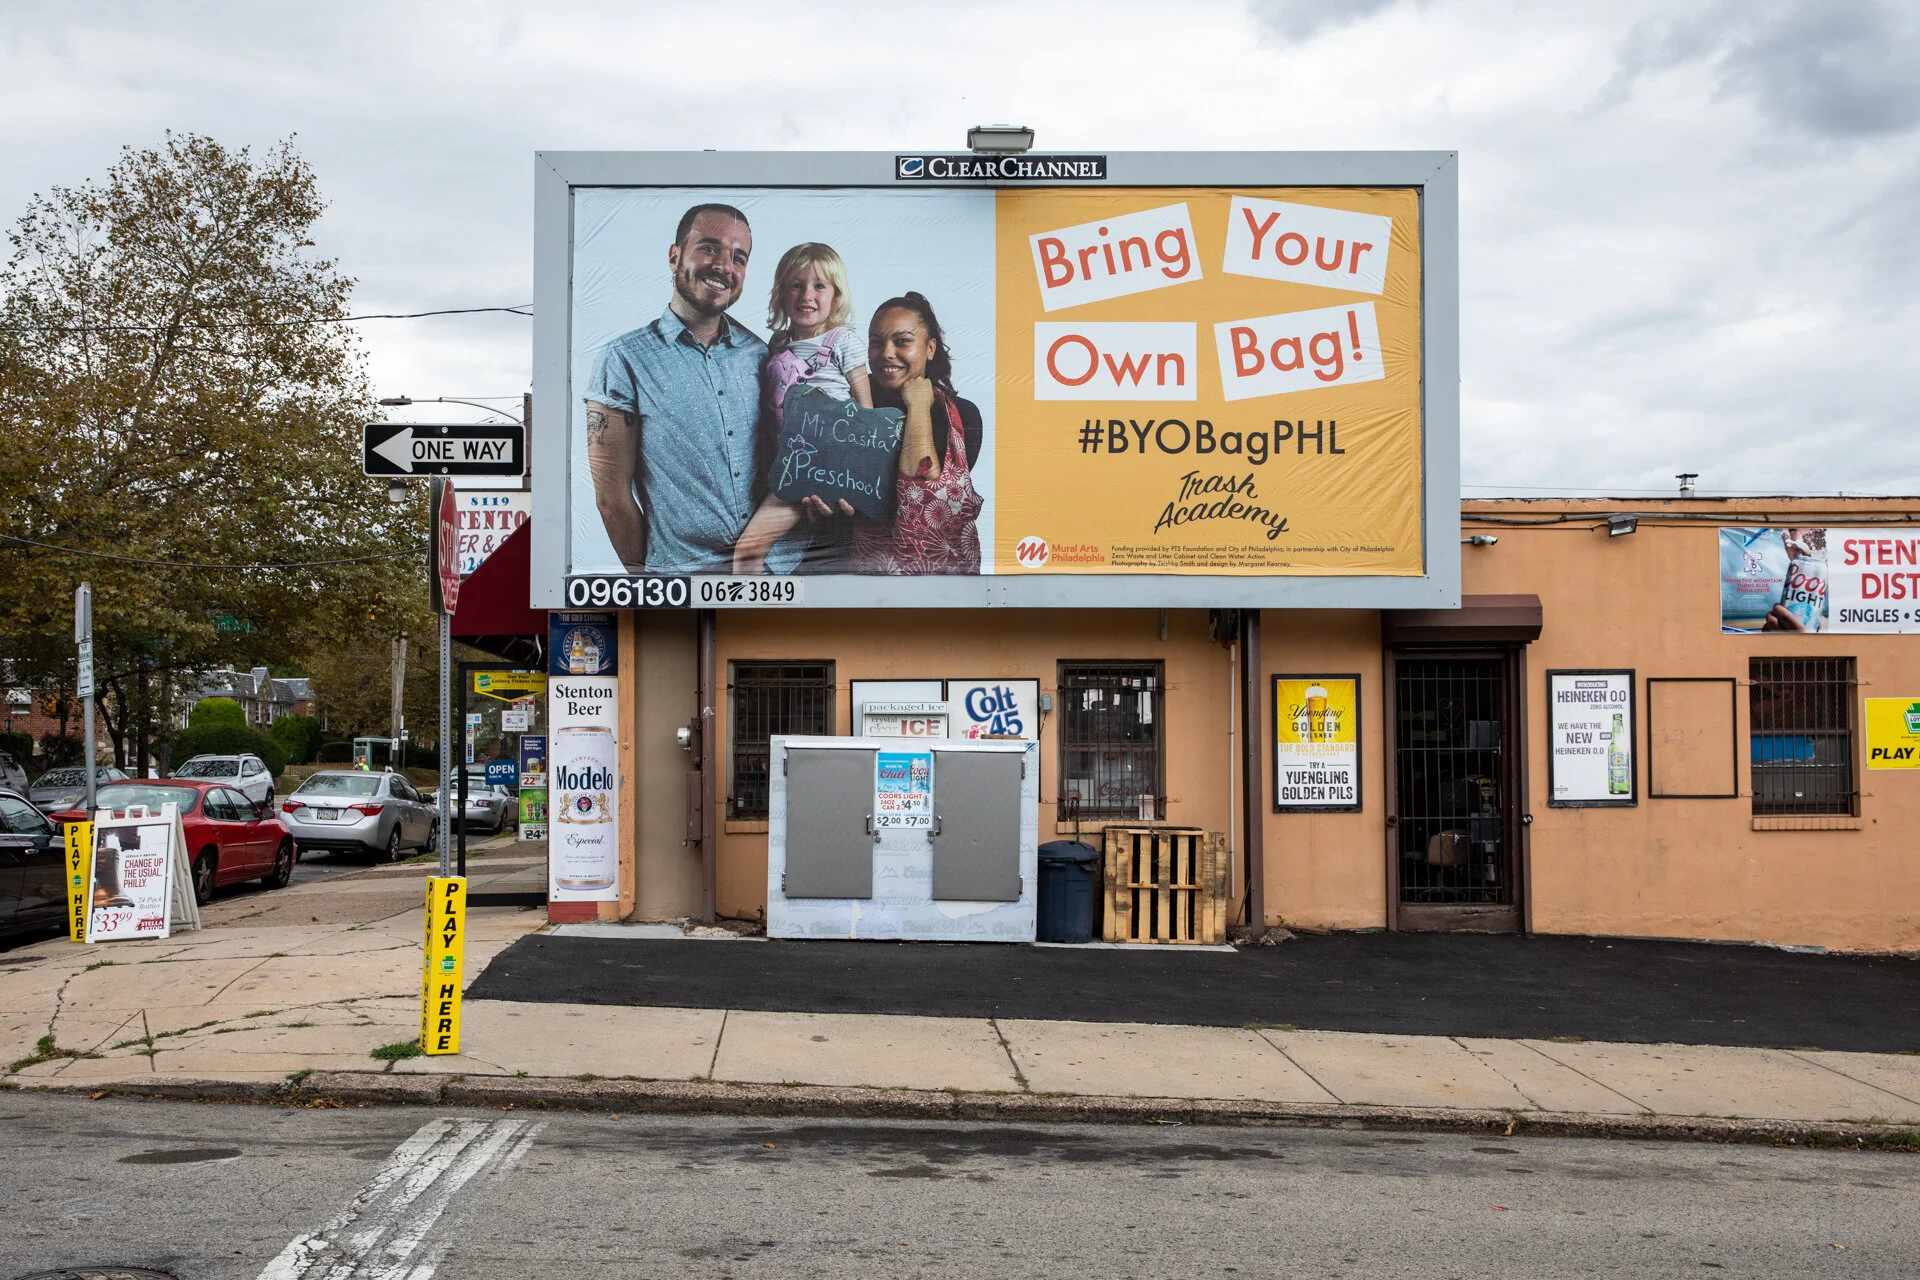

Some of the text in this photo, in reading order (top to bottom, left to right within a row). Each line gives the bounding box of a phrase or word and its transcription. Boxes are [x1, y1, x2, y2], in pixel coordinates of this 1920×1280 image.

[1037, 207, 1373, 289] Bring Your
[1046, 310, 1362, 387] Own Bag!
[801, 411, 890, 452] Mi Casita
[1078, 419, 1345, 465] #BYOBagPHL
[412, 440, 507, 460] ONE WAY
[795, 452, 882, 499] Preschool
[1178, 470, 1258, 502] Trash
[471, 497, 510, 506] 8119
[458, 510, 528, 530] TENTO
[1154, 494, 1290, 540] Academy
[482, 534, 495, 553] &
[1051, 544, 1078, 553] Mural
[1079, 544, 1099, 553] Arts
[1111, 545, 1134, 553] Funding
[1135, 545, 1160, 553] provided
[1162, 545, 1169, 553] by
[1228, 545, 1239, 553] City
[1292, 545, 1325, 553] partnership
[1340, 545, 1351, 553] City
[1359, 545, 1395, 553] Philadelphia
[1051, 553, 1105, 562] Philadelphia
[1843, 538, 1920, 566] STEN
[1111, 560, 1147, 568] Photography
[1209, 560, 1228, 568] design
[1238, 560, 1265, 568] Margaret
[569, 578, 687, 606] 096130
[1784, 589, 1824, 609] LIGHT
[1839, 609, 1899, 623] SINGLES
[555, 684, 613, 699] Stenton
[1557, 690, 1627, 703] HEINEKEN 0.0
[567, 701, 602, 716] Beer
[869, 702, 944, 712] packaged ice
[964, 684, 1018, 722] Colt
[1288, 703, 1346, 720] Yuengling
[900, 719, 941, 736] ICE
[989, 709, 1023, 736] 45
[1292, 721, 1341, 732] GOLDEN
[1558, 722, 1569, 730] WE
[1570, 722, 1588, 730] HAVE
[1566, 732, 1593, 744] NEW
[1280, 743, 1355, 753] THE GOLD STANDARD
[1555, 746, 1605, 755] HEINEKEN 0.0
[1871, 748, 1915, 760] PLAY
[488, 764, 515, 775] OPEN
[1309, 761, 1326, 769] TRY A
[556, 765, 613, 790] Modelo
[879, 768, 908, 779] Chill
[1286, 771, 1349, 785] YUENGLING
[1282, 786, 1354, 800] GOLDEN PILS
[877, 816, 902, 827] $2.00
[904, 816, 929, 827] $7.00
[563, 833, 603, 848] Especial
[124, 857, 164, 869] CHANGE UP
[124, 869, 137, 879] THE
[70, 826, 84, 939] PLAY HERE
[442, 883, 459, 948] PLAY
[437, 984, 454, 1050] HERE
